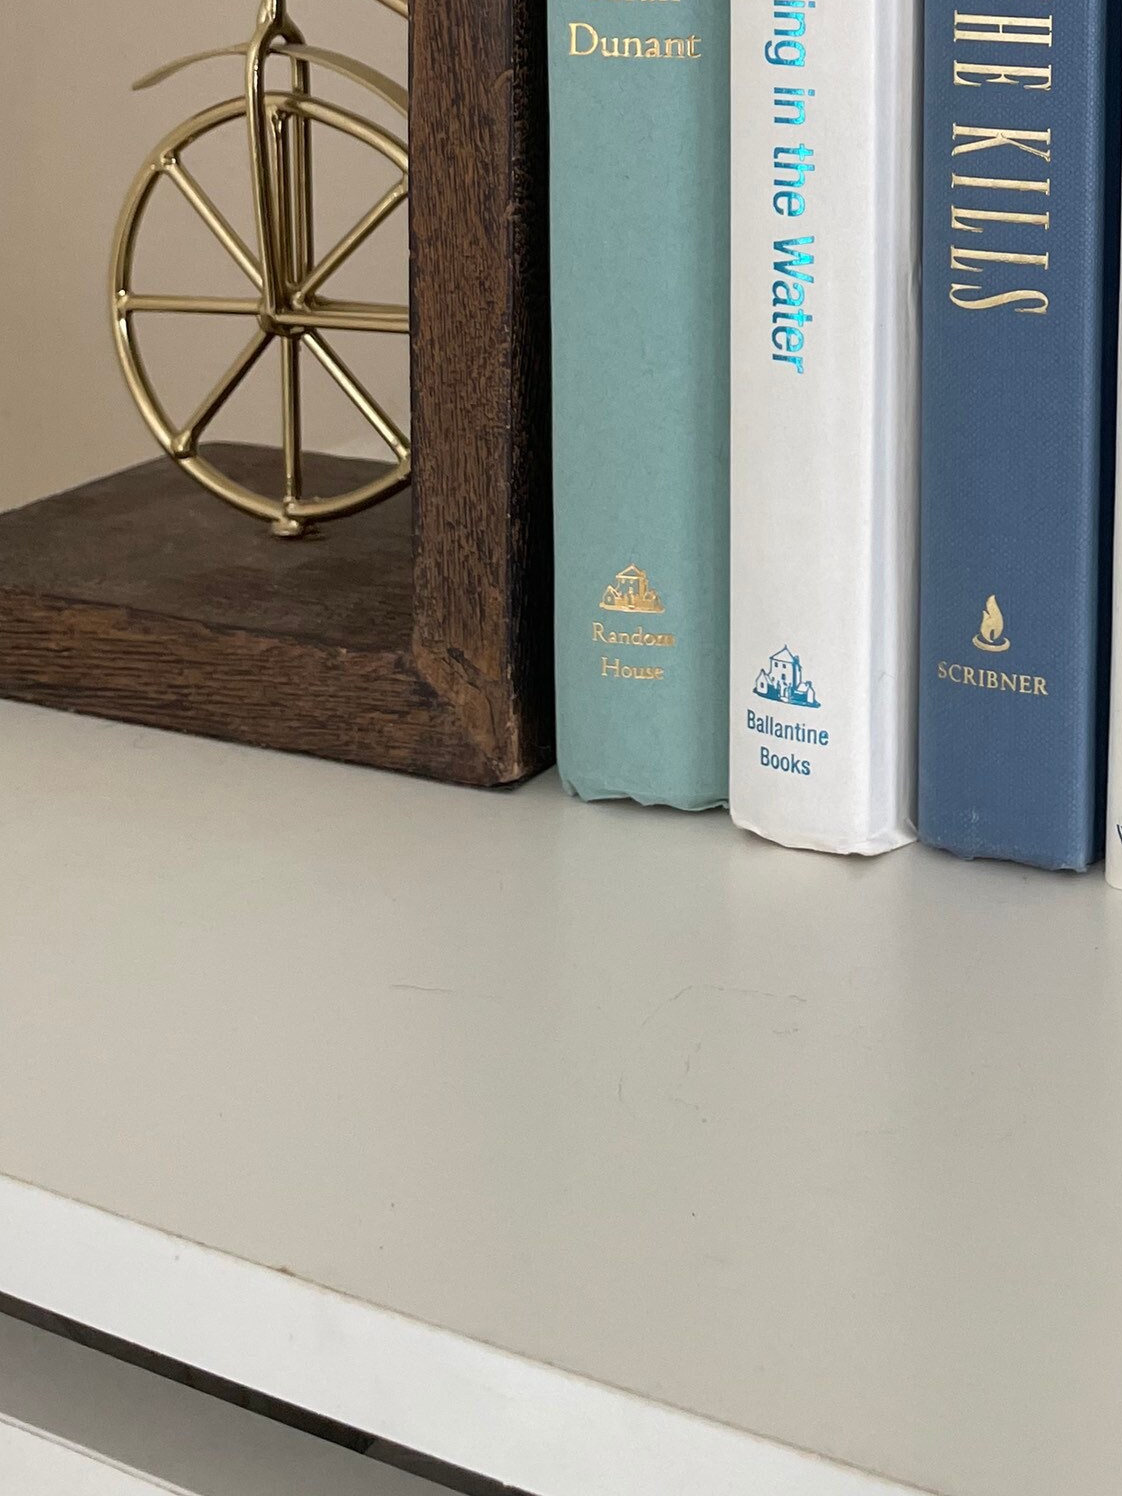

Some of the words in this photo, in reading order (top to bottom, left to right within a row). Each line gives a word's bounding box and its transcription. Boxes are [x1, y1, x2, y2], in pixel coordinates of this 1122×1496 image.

[568, 23, 702, 59] Dunant
[773, 87, 815, 126] in
[773, 143, 815, 218] the
[949, 122, 1051, 314] KILLS
[771, 235, 815, 375] Water
[601, 656, 664, 681] House
[937, 660, 1049, 697] SCRIBNER
[746, 709, 830, 747] Ballantine
[760, 746, 811, 777] Books
